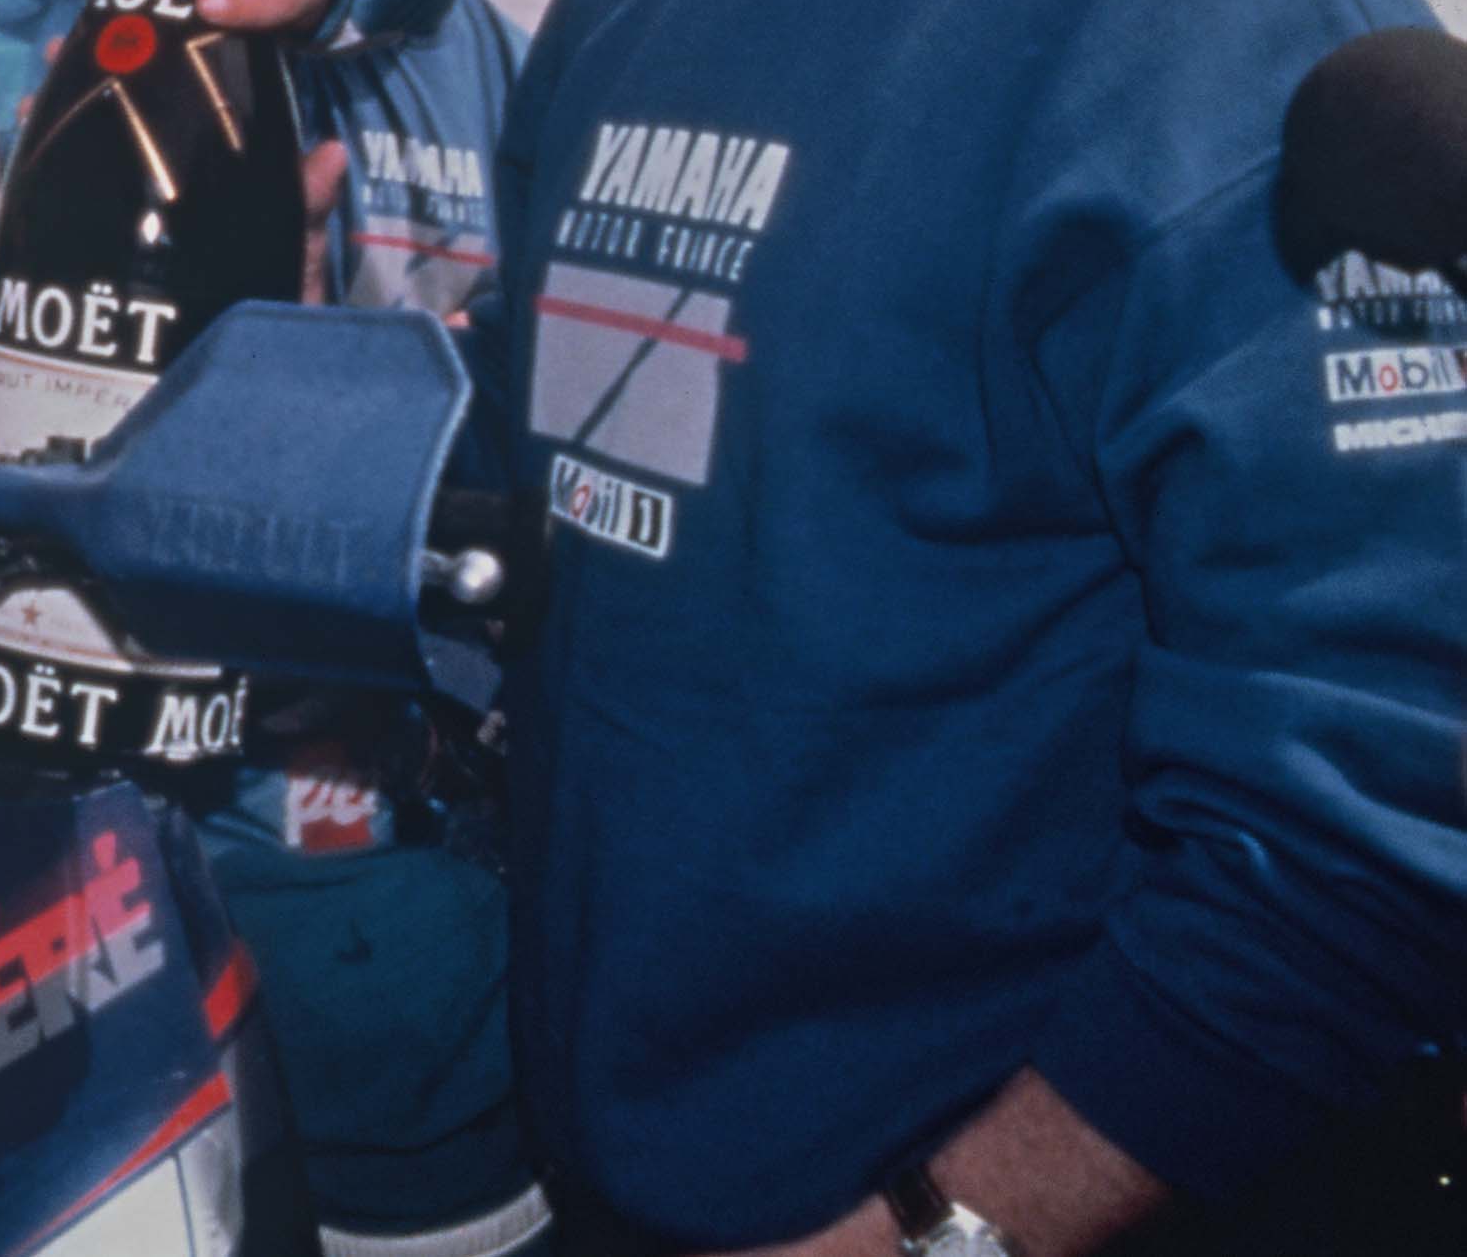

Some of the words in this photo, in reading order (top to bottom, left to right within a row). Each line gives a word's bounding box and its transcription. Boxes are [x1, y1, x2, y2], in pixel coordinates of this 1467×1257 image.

[580, 123, 790, 231] YAMAHA
[1336, 352, 1449, 394] Mobil
[555, 458, 621, 535] Mobil
